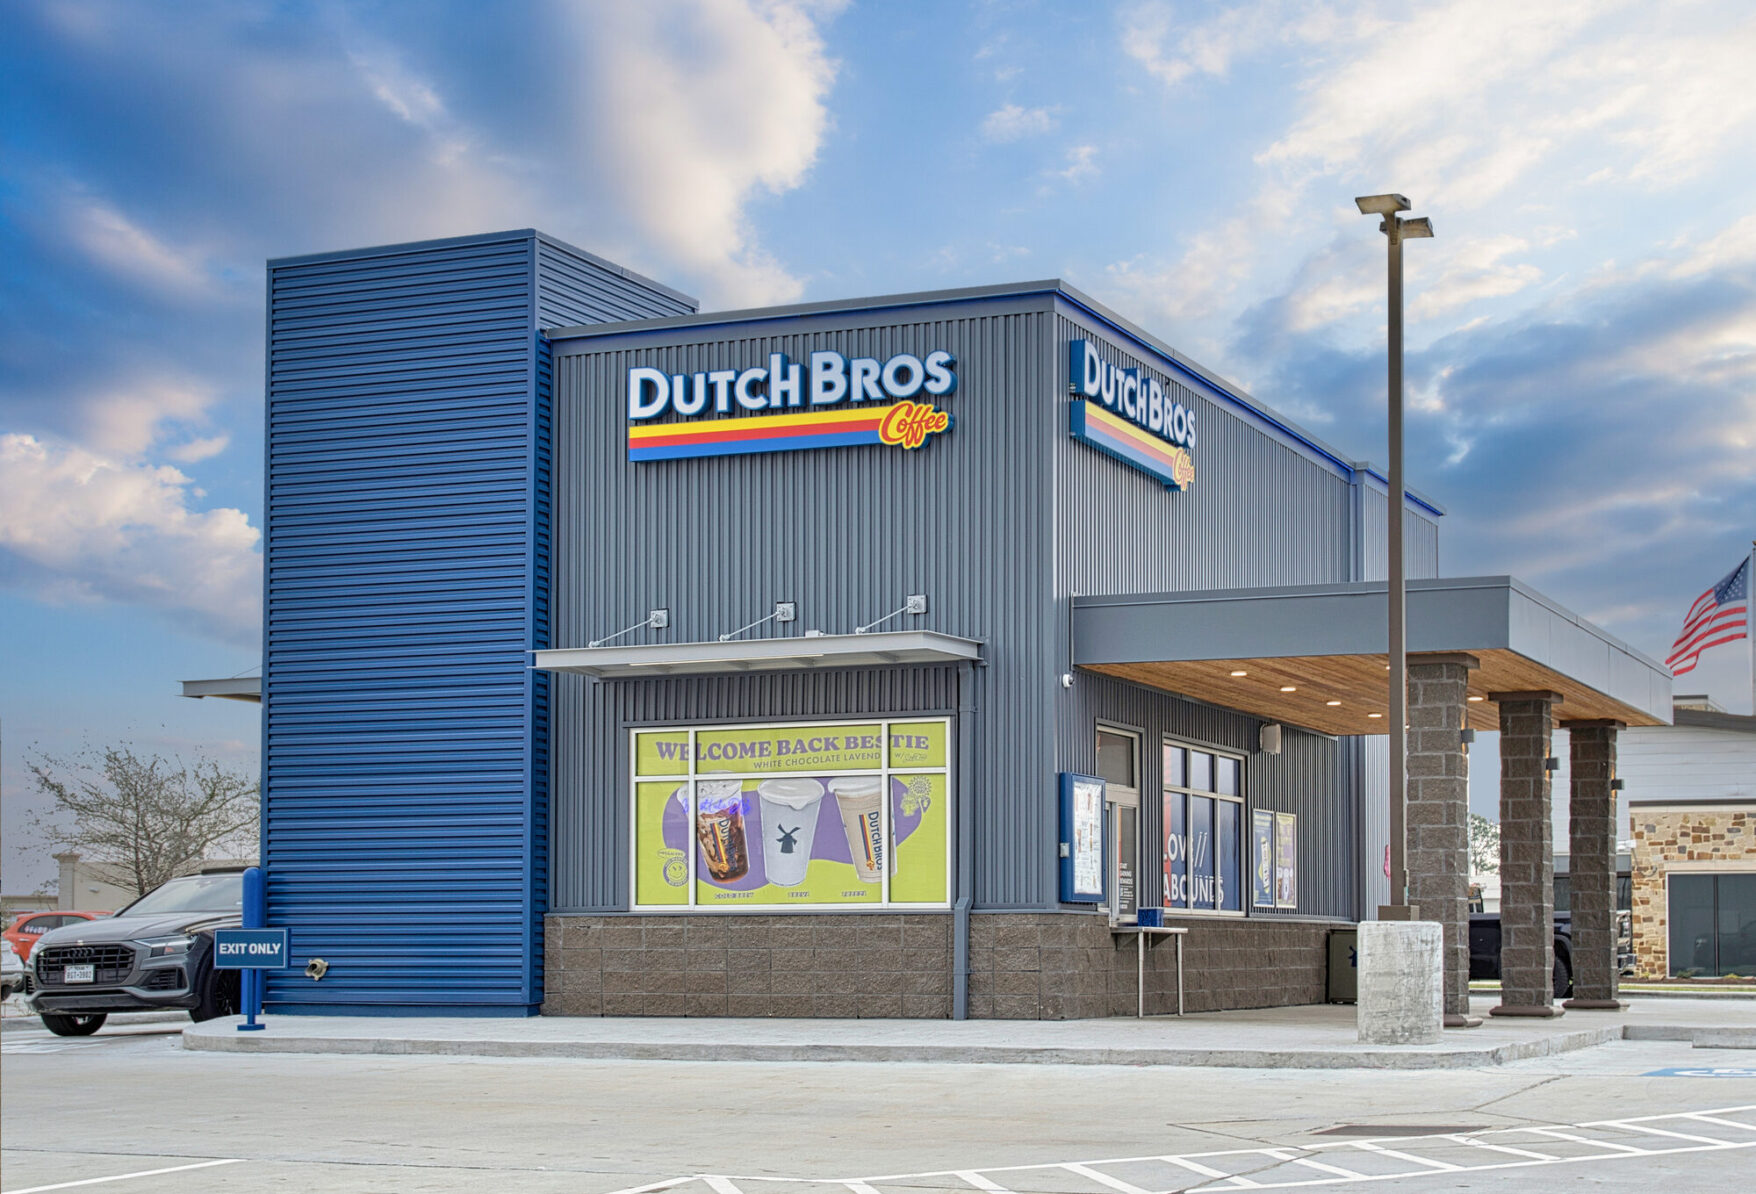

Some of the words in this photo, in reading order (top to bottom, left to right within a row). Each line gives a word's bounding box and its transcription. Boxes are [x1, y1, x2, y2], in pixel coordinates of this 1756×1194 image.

[629, 352, 803, 419] DUTCH
[810, 350, 955, 406] BROS
[1083, 339, 1147, 426] DUTCH
[1149, 377, 1197, 450] BROS
[880, 402, 950, 449] Coffee
[1173, 447, 1195, 491] Coffee
[655, 740, 772, 762] WELCOME
[776, 736, 840, 757] BACK
[844, 734, 929, 750] BESTIE
[753, 758, 782, 769] WHITE
[785, 754, 841, 768] CHOCOLATE
[844, 752, 881, 762] LAVEND
[868, 811, 883, 846] DUTCH
[219, 942, 248, 955] EXIT
[248, 942, 282, 955] ONLY
